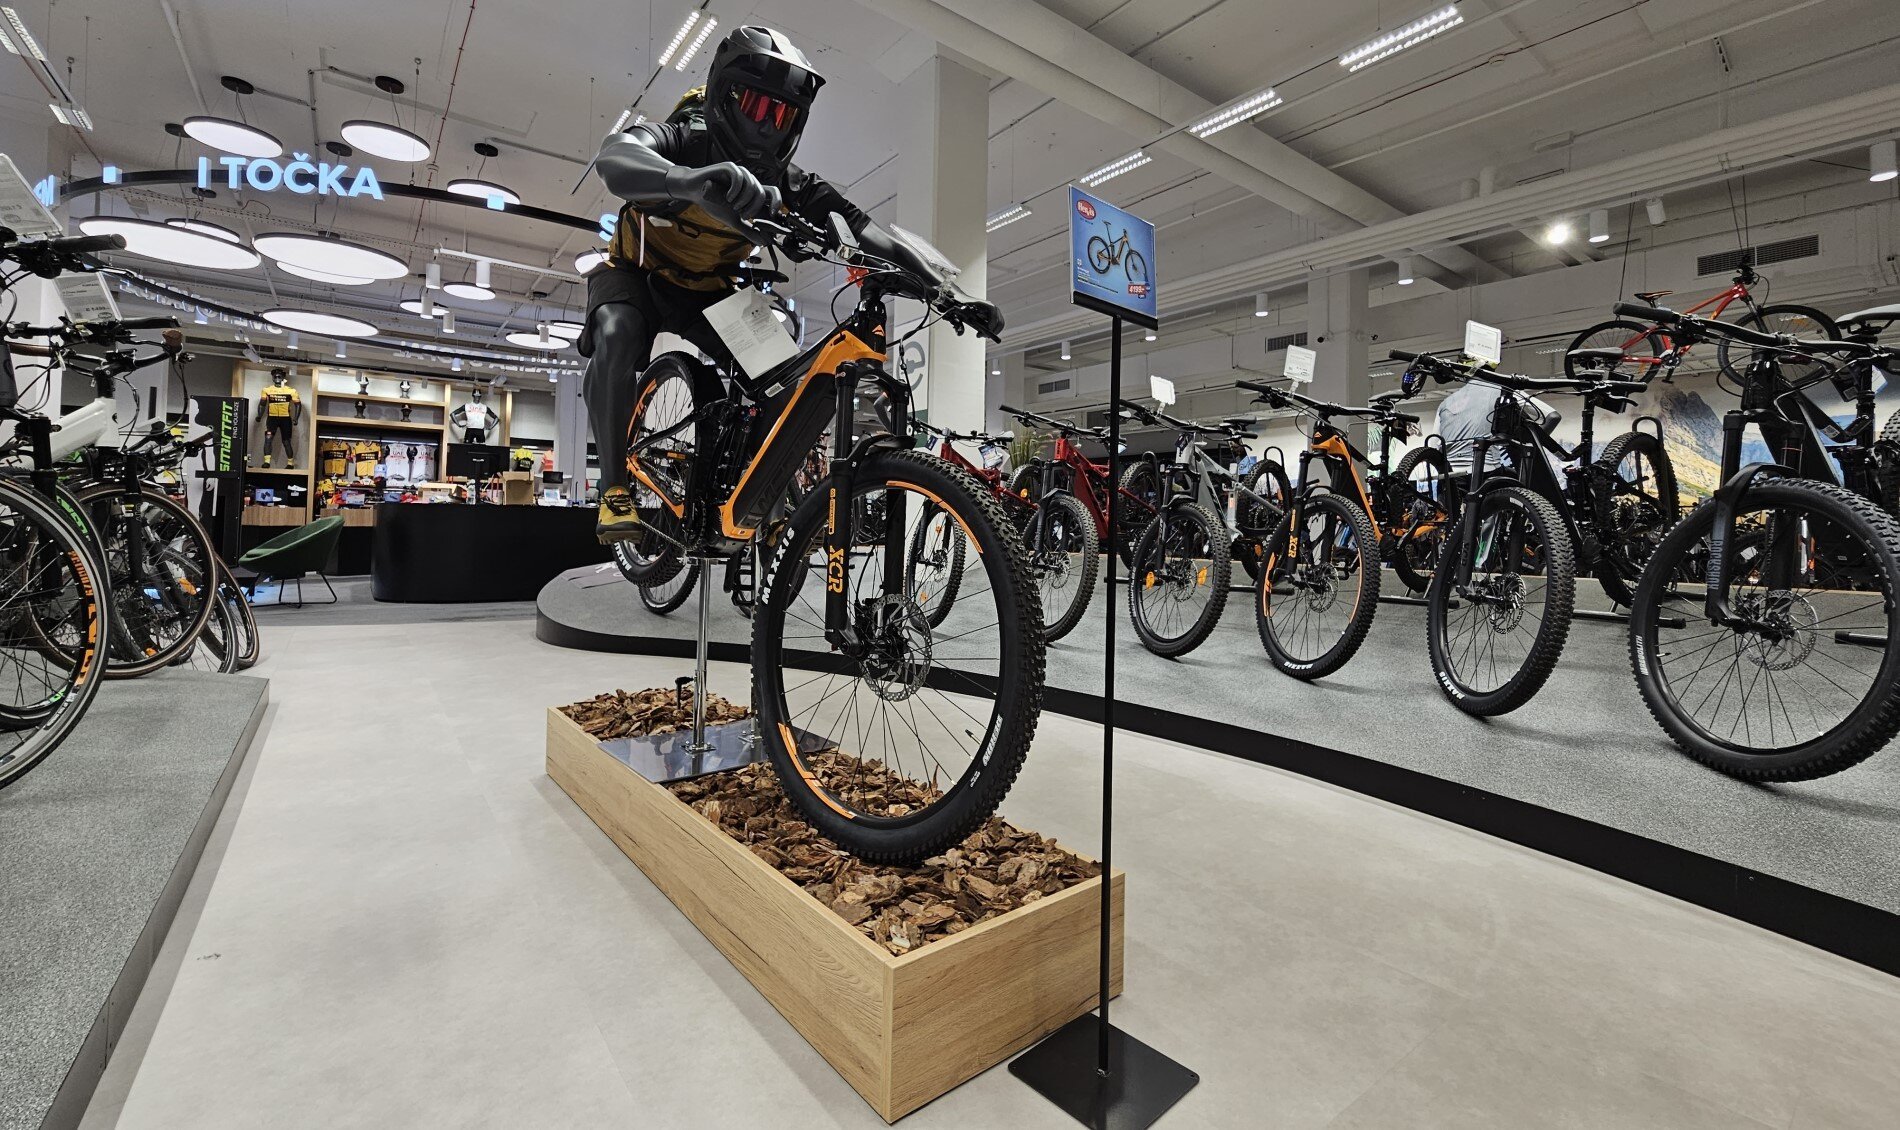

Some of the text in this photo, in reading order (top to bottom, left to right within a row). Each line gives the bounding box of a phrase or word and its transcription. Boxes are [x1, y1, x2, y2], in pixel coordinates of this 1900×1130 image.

[220, 152, 385, 201] TOČKA
[762, 527, 795, 605] MAXXIS
[828, 545, 843, 593] XCR
[1288, 535, 1298, 558] XCR
[1707, 539, 1724, 590] ROCKSHOX
